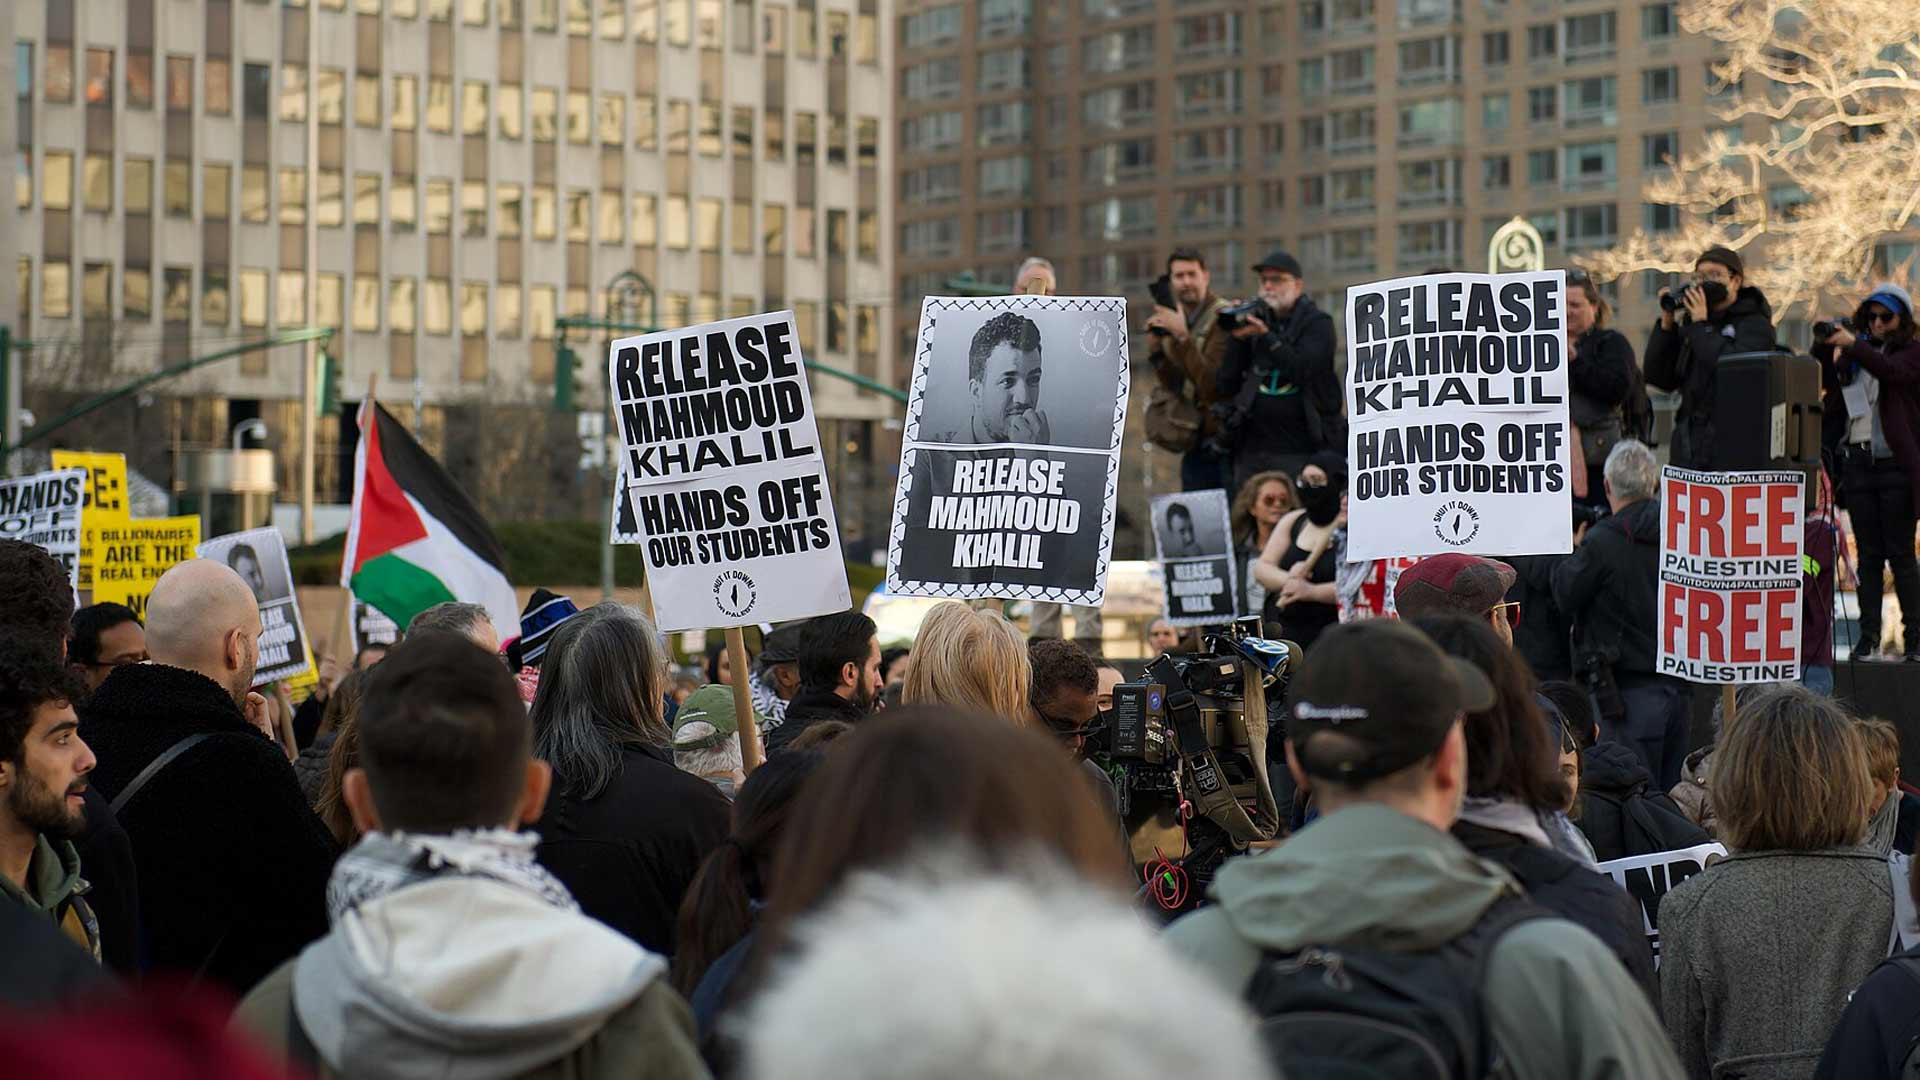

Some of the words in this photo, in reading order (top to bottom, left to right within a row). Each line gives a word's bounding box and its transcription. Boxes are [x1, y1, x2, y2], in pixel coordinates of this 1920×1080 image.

[1354, 280, 1560, 344] RELEASE
[616, 322, 798, 401] RELEASE
[1354, 334, 1560, 384] MAHMOUD
[621, 381, 805, 446] MAHMOUD
[1355, 376, 1562, 416] KHALIL
[630, 429, 814, 479] KHALIL
[1356, 422, 1485, 471] HANDS
[1498, 423, 1563, 462] OFF
[0, 477, 80, 515] HANDS
[952, 458, 1066, 495] RELEASE
[1356, 468, 1410, 501] OUR
[1418, 463, 1564, 494] STUDENTS
[640, 485, 750, 536] HANDS
[758, 474, 822, 524] OFF
[928, 495, 1081, 535] MAHMOUD
[1433, 504, 1449, 522] SHUT
[1448, 500, 1456, 510] IT
[1666, 480, 1798, 558] FREE
[101, 528, 194, 542] BILLIONAIRES
[105, 545, 144, 563] ARE
[154, 545, 190, 561] THE
[648, 533, 696, 569] OUR
[698, 518, 831, 566] STUDENTS
[952, 532, 1044, 570] KHALIL
[101, 567, 134, 580] REAL
[1665, 554, 1798, 577] PALESTINE
[1664, 583, 1796, 664] FREE
[1663, 657, 1795, 682] PALESTINE
